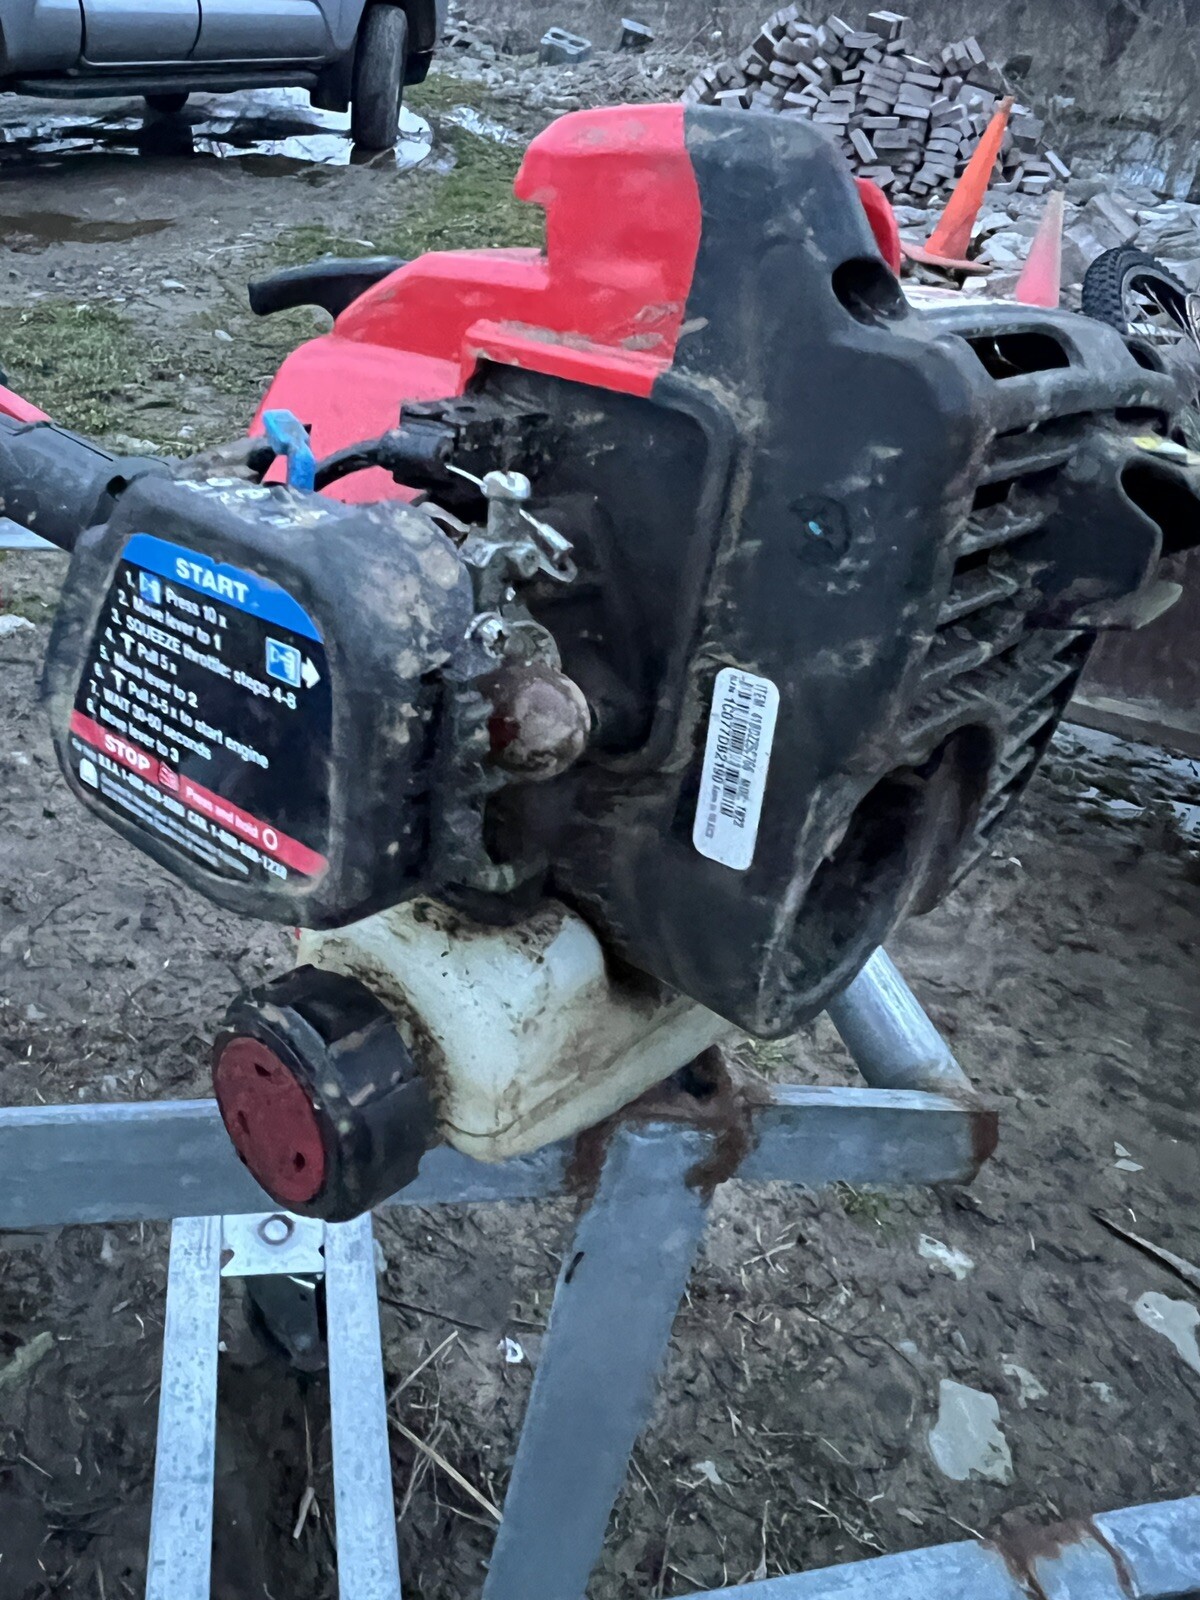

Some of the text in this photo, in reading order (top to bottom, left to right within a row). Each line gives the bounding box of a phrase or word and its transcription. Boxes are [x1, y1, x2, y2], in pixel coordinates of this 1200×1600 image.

[164, 585, 201, 618] Press
[175, 557, 250, 604] START
[132, 594, 165, 623] Move
[165, 610, 196, 638] lever
[196, 625, 212, 646] to
[213, 633, 222, 651] 1
[113, 650, 143, 680] Move
[143, 666, 173, 695] lever
[173, 683, 187, 702] to
[187, 691, 199, 709] 2
[125, 614, 182, 656] SQUEEZE
[232, 669, 272, 698] steps
[272, 686, 298, 710] 4-8
[137, 642, 160, 667] Pull
[102, 686, 131, 714] WAIT
[163, 724, 212, 761] seconds
[752, 683, 769, 708] ITEM
[100, 704, 128, 733] Move
[127, 721, 156, 749] lever
[156, 739, 169, 757] to
[169, 746, 180, 763] 3
[104, 733, 151, 771] STOP
[127, 680, 150, 705] Pull
[149, 692, 169, 715] 3-5
[179, 709, 193, 728] to
[194, 719, 223, 745] start
[224, 736, 270, 770] engine
